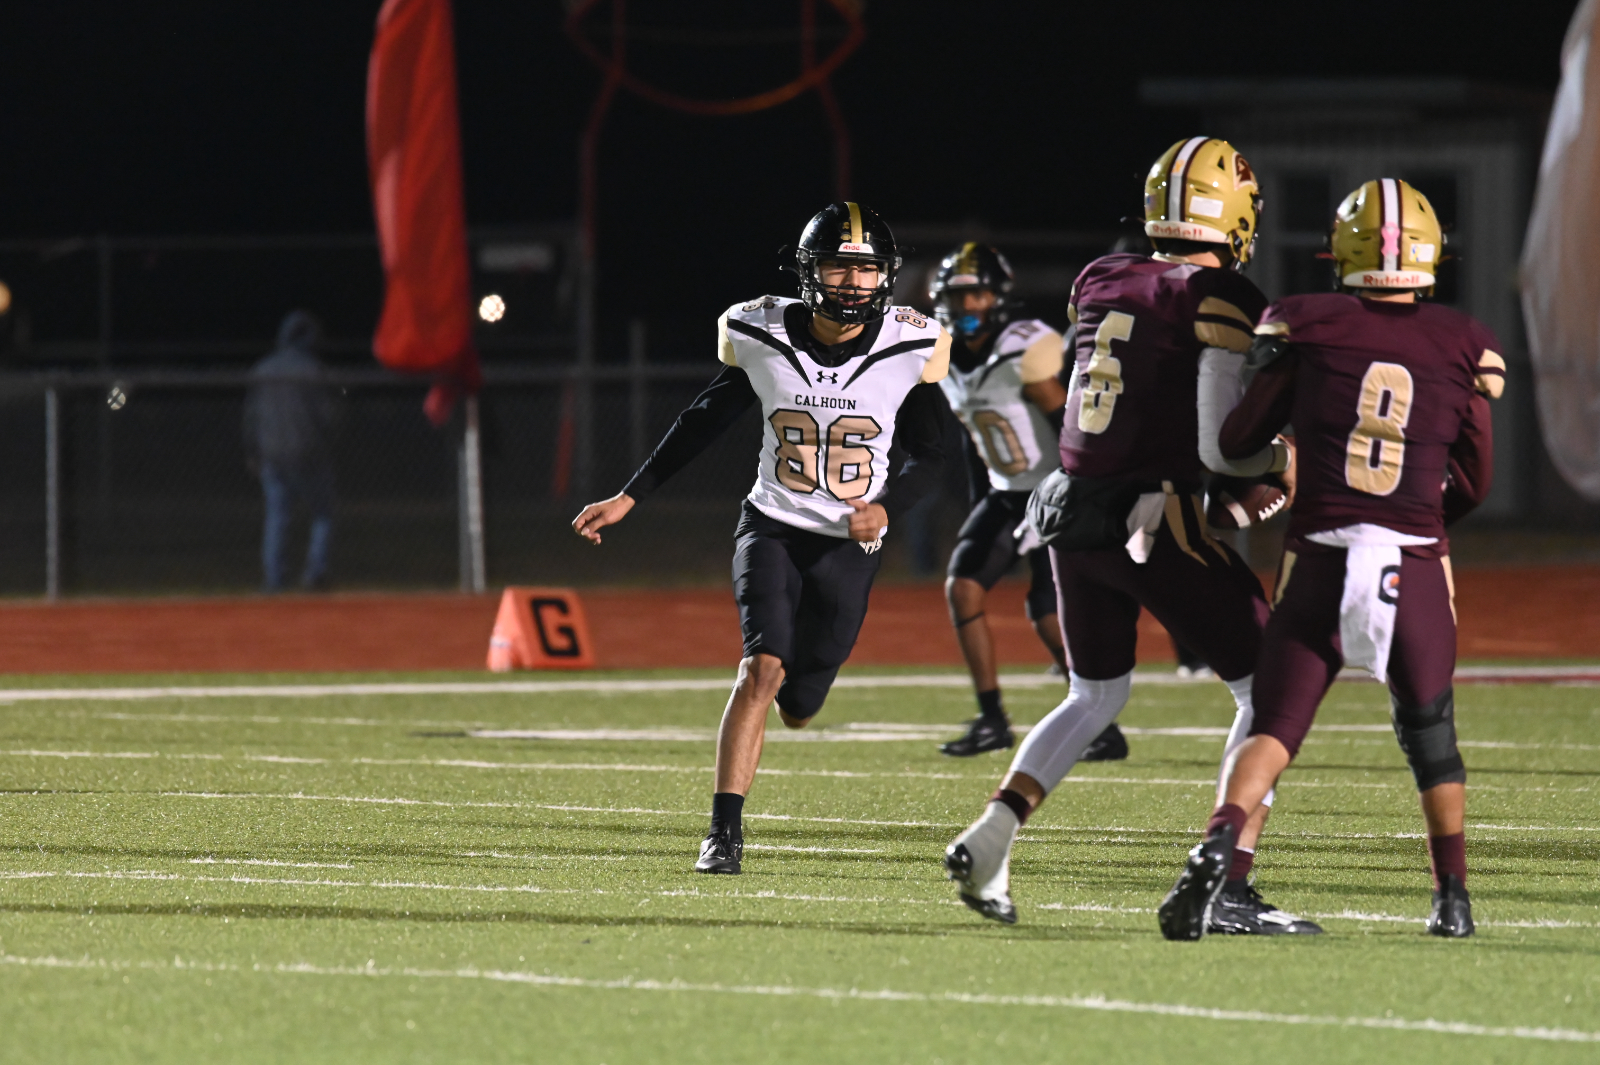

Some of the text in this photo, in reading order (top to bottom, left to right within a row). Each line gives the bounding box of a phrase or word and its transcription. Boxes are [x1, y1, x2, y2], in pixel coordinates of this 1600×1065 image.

[1363, 274, 1420, 287] Riddell
[794, 394, 857, 410] CALHOUN
[1344, 361, 1414, 496] 8
[767, 407, 882, 502] 86
[530, 597, 580, 658] G
